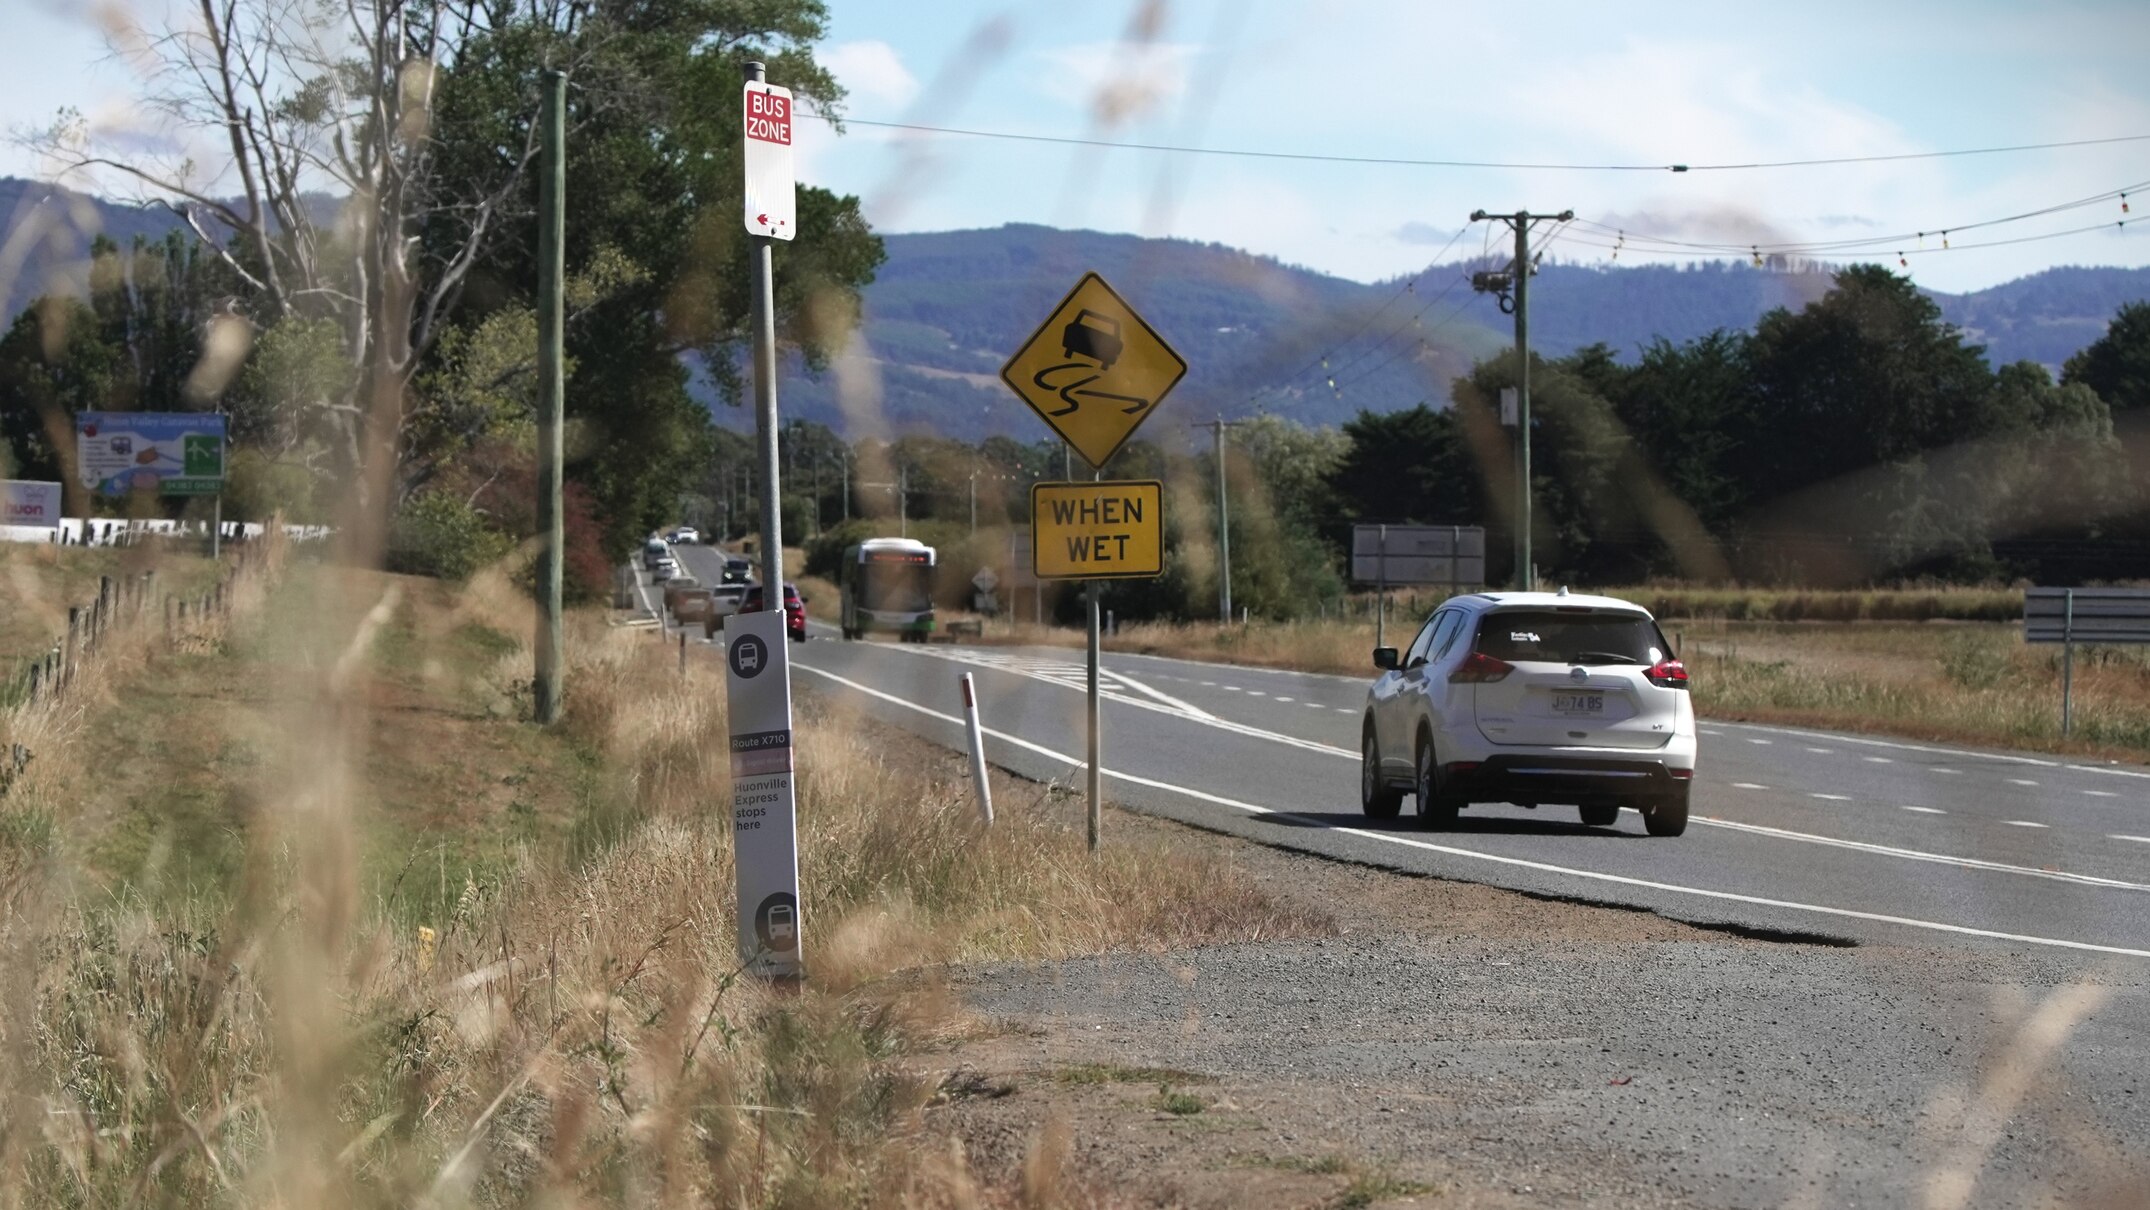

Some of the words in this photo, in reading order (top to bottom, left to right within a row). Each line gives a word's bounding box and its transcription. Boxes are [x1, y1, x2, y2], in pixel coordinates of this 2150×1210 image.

[753, 95, 784, 118] BUS
[748, 117, 789, 142] ZONE
[4, 499, 44, 515] huon
[1052, 498, 1142, 525] WHEN
[1067, 535, 1130, 562] WET
[733, 739, 759, 749] Route
[762, 734, 785, 745] X710
[734, 779, 787, 793] Huonville
[735, 793, 779, 806] Express
[736, 807, 767, 818] stops
[736, 821, 761, 831] here
